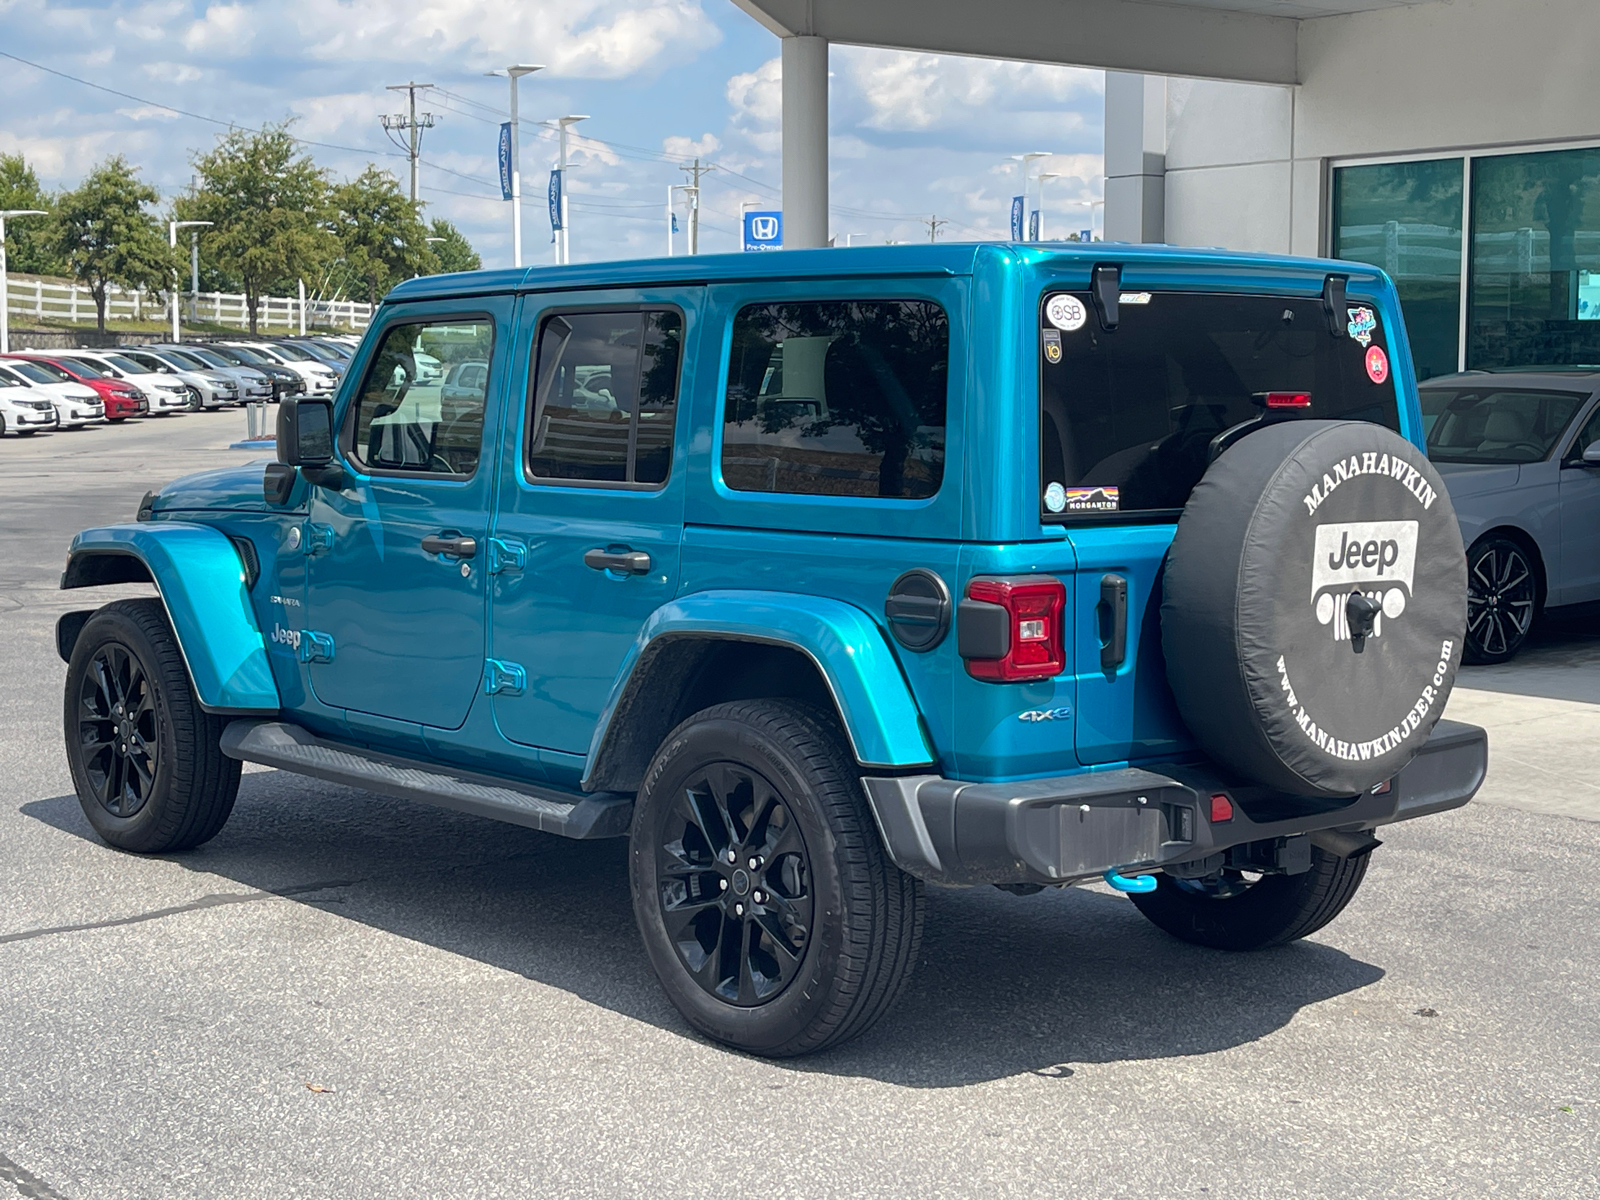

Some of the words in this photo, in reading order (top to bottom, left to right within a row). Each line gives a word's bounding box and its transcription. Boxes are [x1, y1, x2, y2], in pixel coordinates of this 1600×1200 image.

[1069, 501, 1117, 509] MORGANTON
[1303, 452, 1437, 515] MANAHAWKIN
[1329, 531, 1398, 576] Jeep
[271, 623, 301, 650] Jeep
[1277, 640, 1453, 761] www.MANAHAWKINJEEP.com
